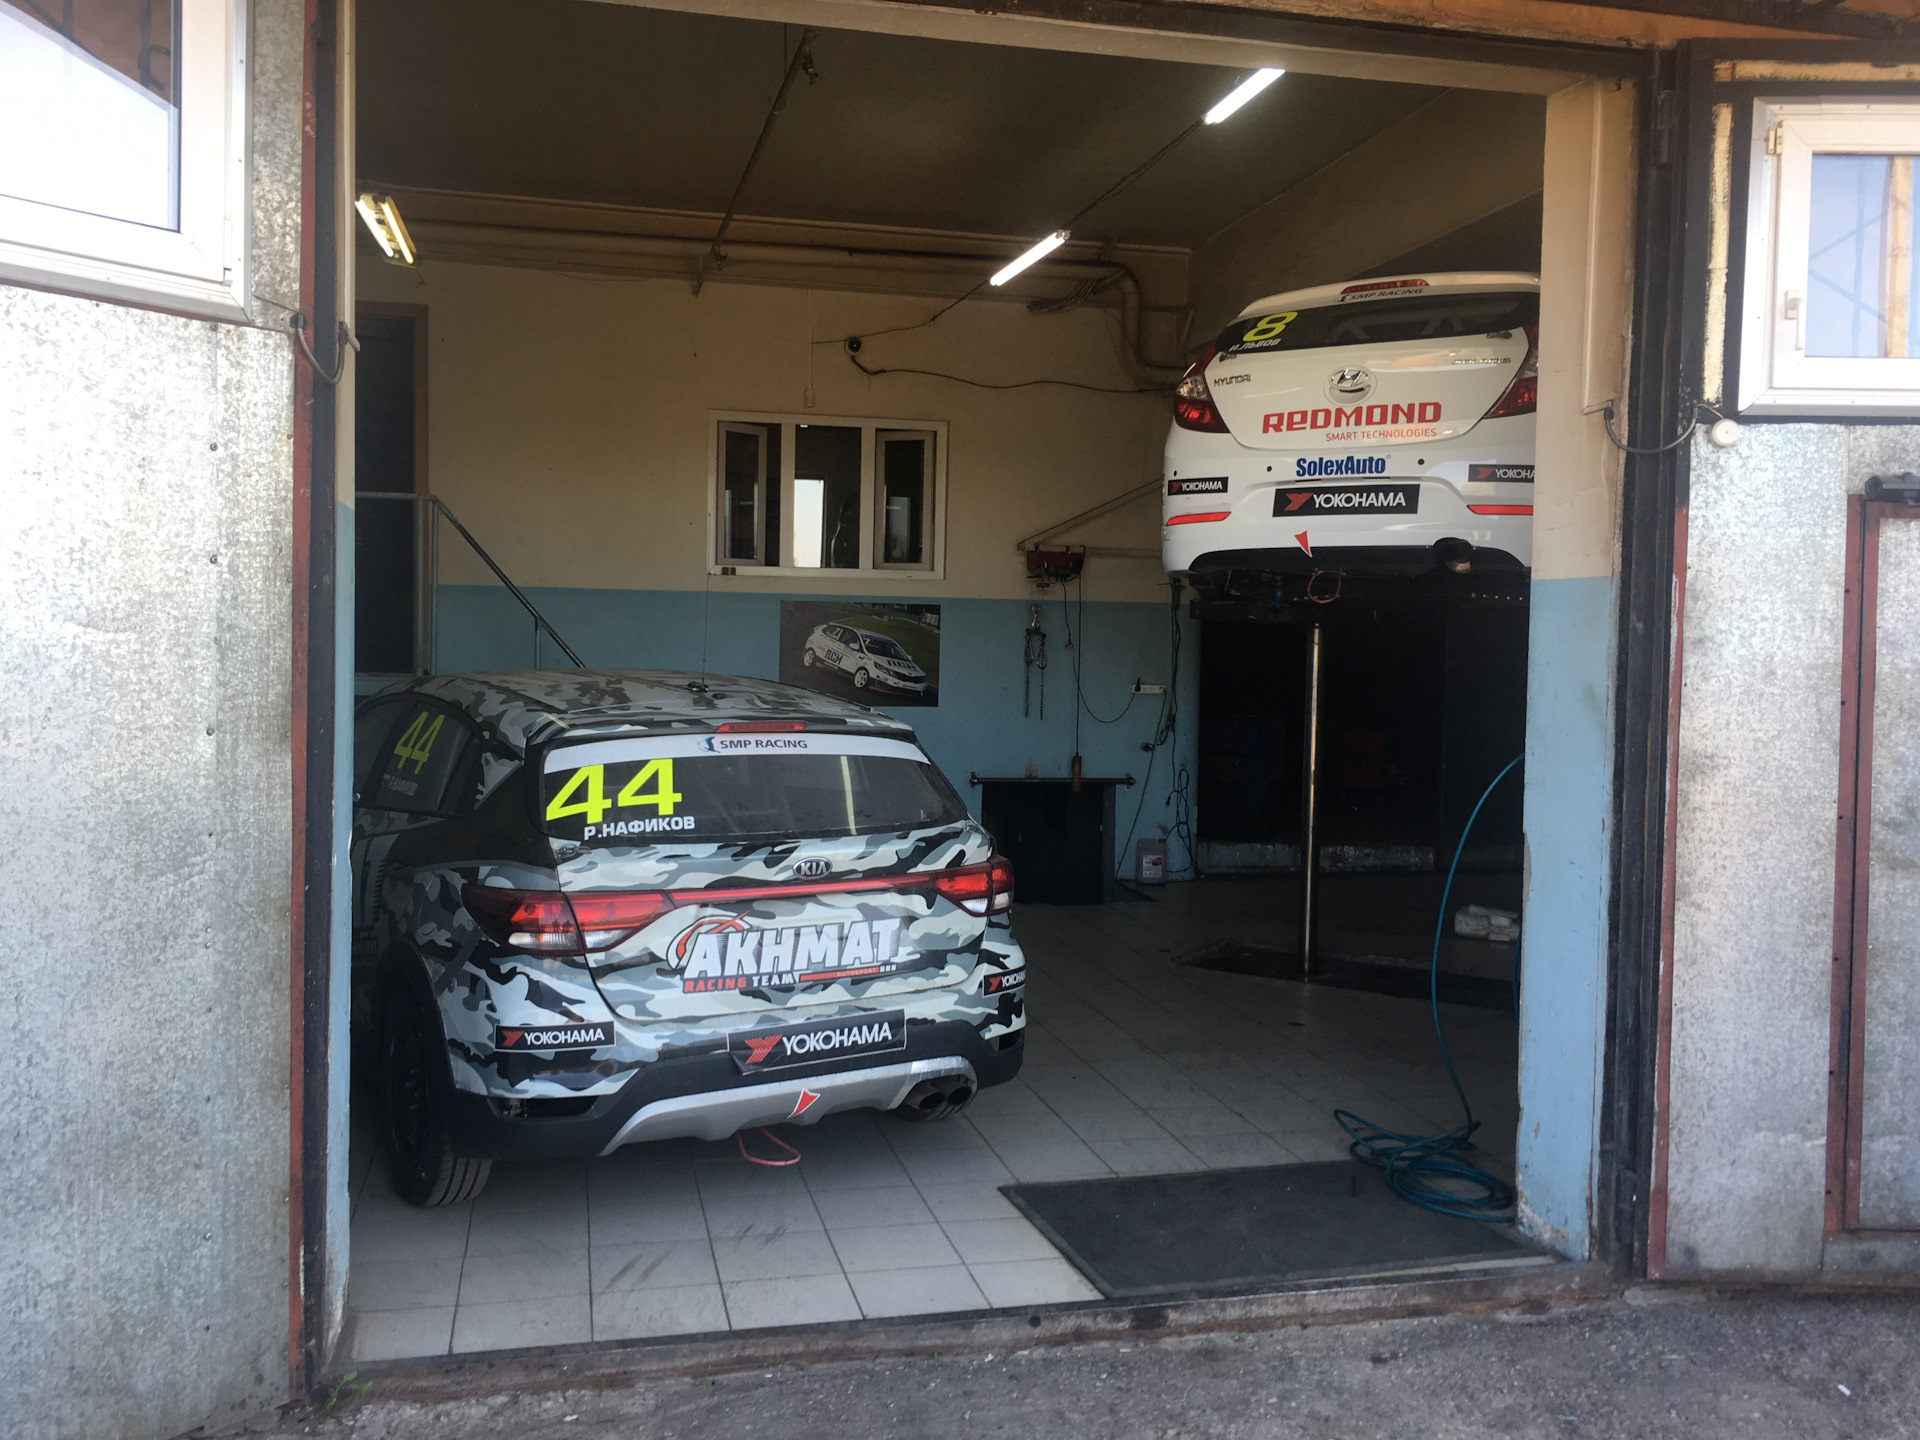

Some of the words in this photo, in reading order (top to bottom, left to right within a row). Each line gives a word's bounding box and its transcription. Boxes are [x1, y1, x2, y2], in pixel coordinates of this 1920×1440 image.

[1349, 292, 1376, 300] SMP
[1377, 288, 1424, 297] RACING
[1242, 311, 1299, 342] 8
[1213, 373, 1252, 386] HYUNDAI
[1262, 401, 1442, 435] REDMOND
[1325, 431, 1358, 442] SMART
[1361, 428, 1437, 440] TECHNOLOGIES
[1295, 455, 1387, 477] SolexAuto
[1495, 468, 1536, 480] YOKOHA
[1181, 480, 1223, 492] YOKOHAMA
[1312, 491, 1407, 509] YOKOHAMA
[392, 710, 446, 775] 44
[719, 738, 752, 750] SMP
[754, 737, 809, 749] RACING
[545, 757, 683, 825] 44
[583, 815, 696, 841] Р.НАФИКОВ
[799, 861, 828, 876] KIA
[683, 917, 901, 980] AKHMAT
[683, 976, 748, 993] RACING
[752, 972, 796, 987] TEAM
[1001, 969, 1026, 988] YOKOHA
[523, 1027, 605, 1046] YOKOHAMA
[781, 1021, 893, 1057] YOKOHAMA
